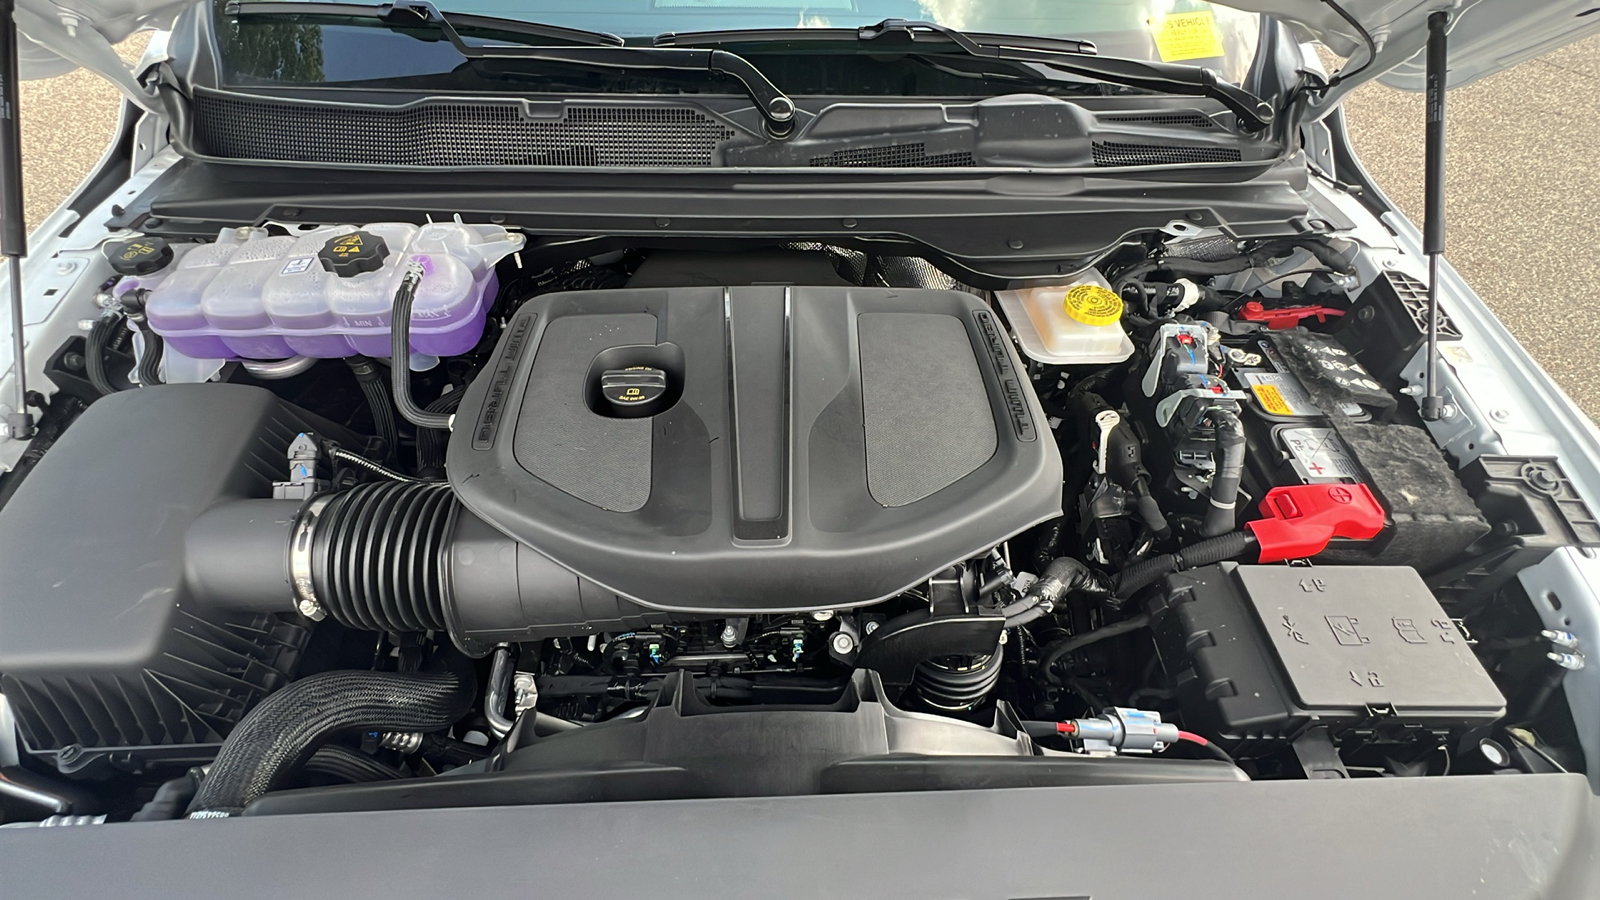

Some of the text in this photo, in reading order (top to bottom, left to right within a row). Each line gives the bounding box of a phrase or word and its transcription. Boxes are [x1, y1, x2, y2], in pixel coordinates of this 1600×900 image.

[477, 315, 531, 443] TWIN TURBO
[978, 311, 1029, 436] TWIN TURBO
